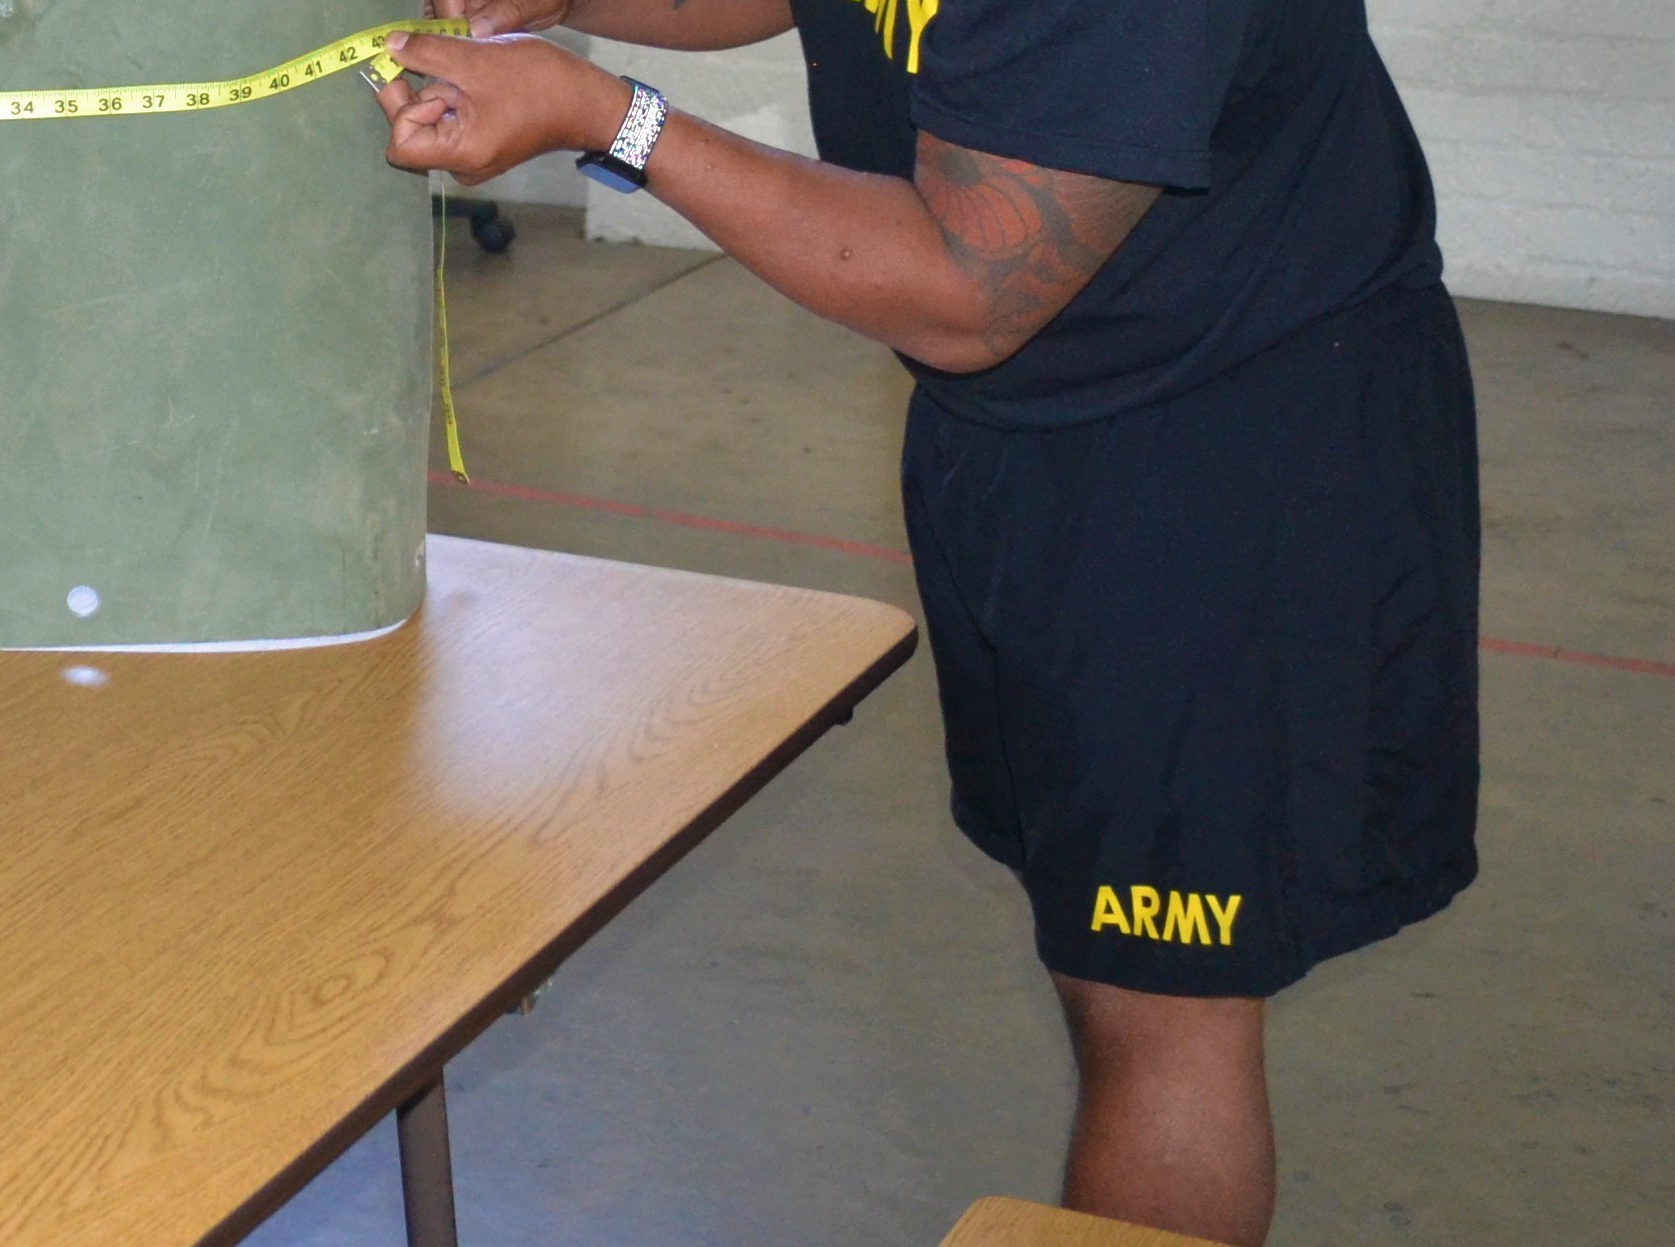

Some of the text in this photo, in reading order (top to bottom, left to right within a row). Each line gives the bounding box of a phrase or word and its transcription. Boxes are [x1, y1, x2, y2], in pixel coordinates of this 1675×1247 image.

[10, 101, 35, 115] 34
[54, 99, 79, 114] 35
[98, 97, 123, 112] 36
[142, 94, 165, 109] 37
[186, 92, 210, 107] 38
[229, 86, 252, 102] 39
[269, 73, 290, 90] 40
[304, 60, 323, 77] 41
[339, 46, 358, 64] 42
[1090, 884, 1243, 946] ARMY
